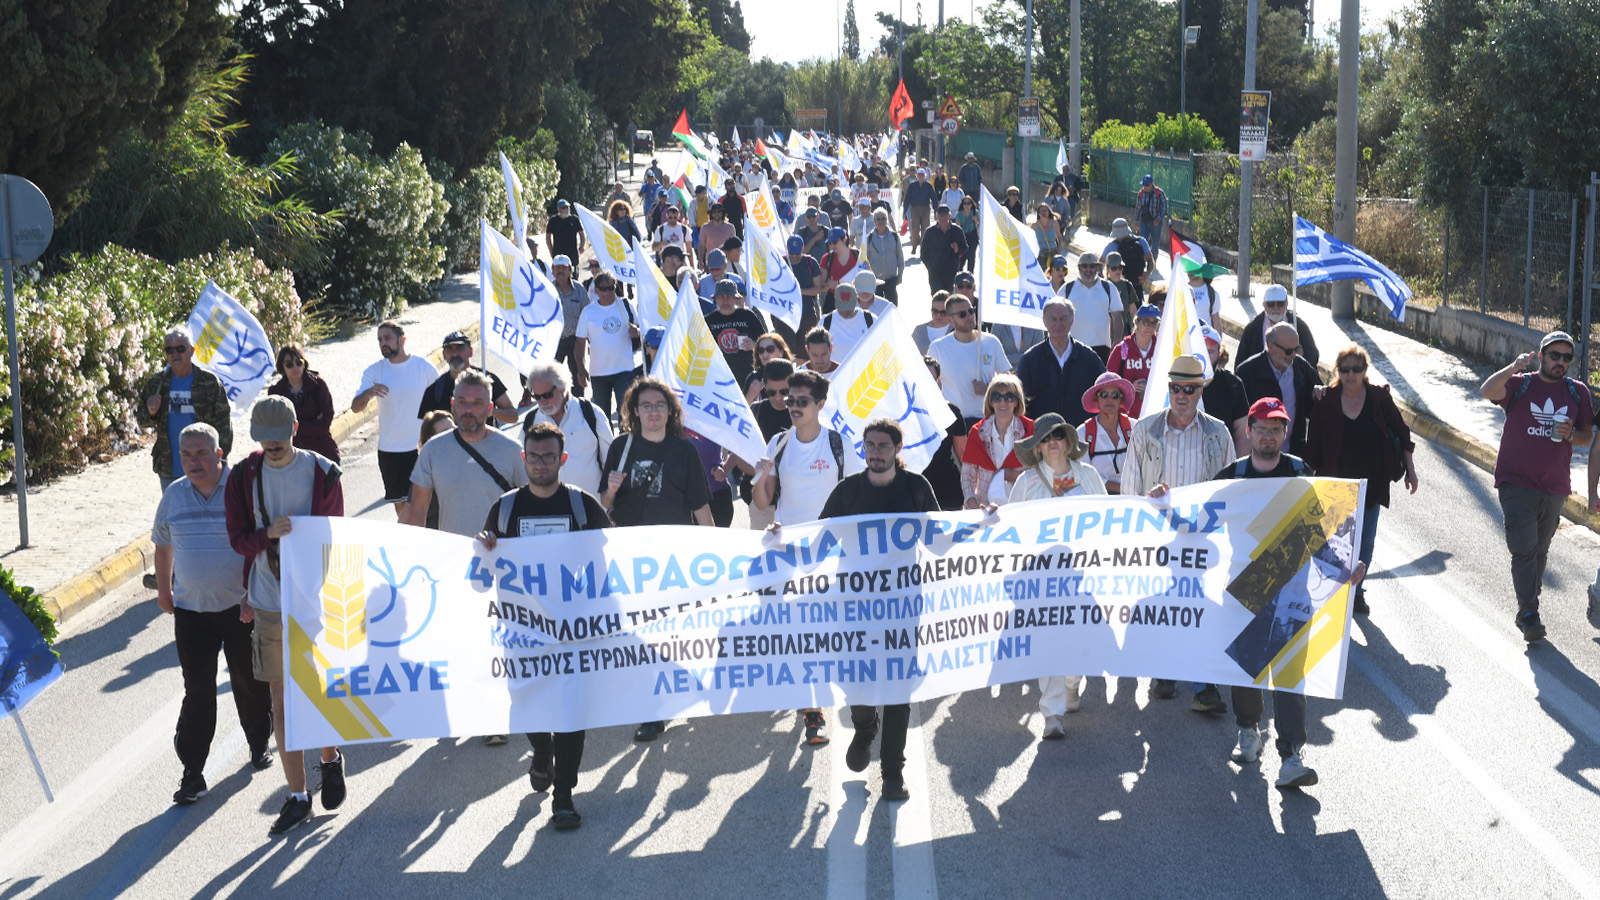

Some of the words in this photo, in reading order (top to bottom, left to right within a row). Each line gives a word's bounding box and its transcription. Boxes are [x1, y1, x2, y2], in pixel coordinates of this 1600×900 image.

[614, 265, 636, 278] ΕΕΔ
[752, 287, 794, 315] ΕΕΔΥΕ
[996, 289, 1051, 310] ΕΕΔΥ
[492, 316, 543, 360] ΕΕΔΥΕ
[1527, 426, 1552, 437] adid
[464, 556, 547, 596] 42Η
[560, 530, 846, 602] ΜΑΡΑΘΩΝΙΑ
[857, 517, 1021, 555] ΠΟΡΕΙΑ
[1036, 502, 1226, 544] ΕΙΡΗΝΗΣ
[487, 600, 621, 641] ΑΠΕΜΠΛΟΚΗ
[782, 575, 830, 595] ΑΠΟ
[836, 569, 891, 592] ΤΟΥΣ
[897, 554, 1004, 590] ΠΟΛΕΜΟΥΣ
[1010, 554, 1052, 571] ΤΩΝ
[1057, 546, 1208, 569] ΗΠΑ-ΝΑΤΟ-ΕΕ
[682, 602, 791, 631] ΑΠΟΣΤΟΛΗ
[797, 600, 837, 623] ΤΩΝ
[844, 591, 935, 621] ΕΝΟΠΛΩΝ
[940, 578, 1039, 611] ΔΥΝΑΜΕΩΝ
[1046, 575, 1107, 598] ΕΚΤΟΣ
[1111, 575, 1205, 598] ΣΥΝΟΡΩΝ
[1288, 600, 1317, 615] ΕΕΔ
[492, 657, 517, 679] ΟΧΙ
[519, 652, 574, 678] ΣΤΟΥΣ
[579, 635, 728, 673] ΕΥΡΩΝΑΤΟΪΚΟΥΣ
[734, 630, 866, 657] ΕΞΟΠΛΙΣΜΟΥΣ
[884, 628, 911, 650] ΝΑ
[915, 613, 989, 647] ΚΛΕΙΣΟΥΝ
[993, 610, 1009, 631] ΟΙ
[1014, 605, 1076, 629] ΒΑΣΕΙΣ
[1081, 605, 1114, 625] ΤΟΥ
[1118, 605, 1205, 628] ΘΑΝΑΤΟΥ
[326, 660, 450, 699] ΕΕΔΥΕ
[653, 662, 796, 696] ΛΕΥΤΕΡΙΑ
[802, 658, 877, 684] ΣΤΗΝ
[885, 635, 1031, 681] ΠΑΛΑΙΣΤΙΝΗ
